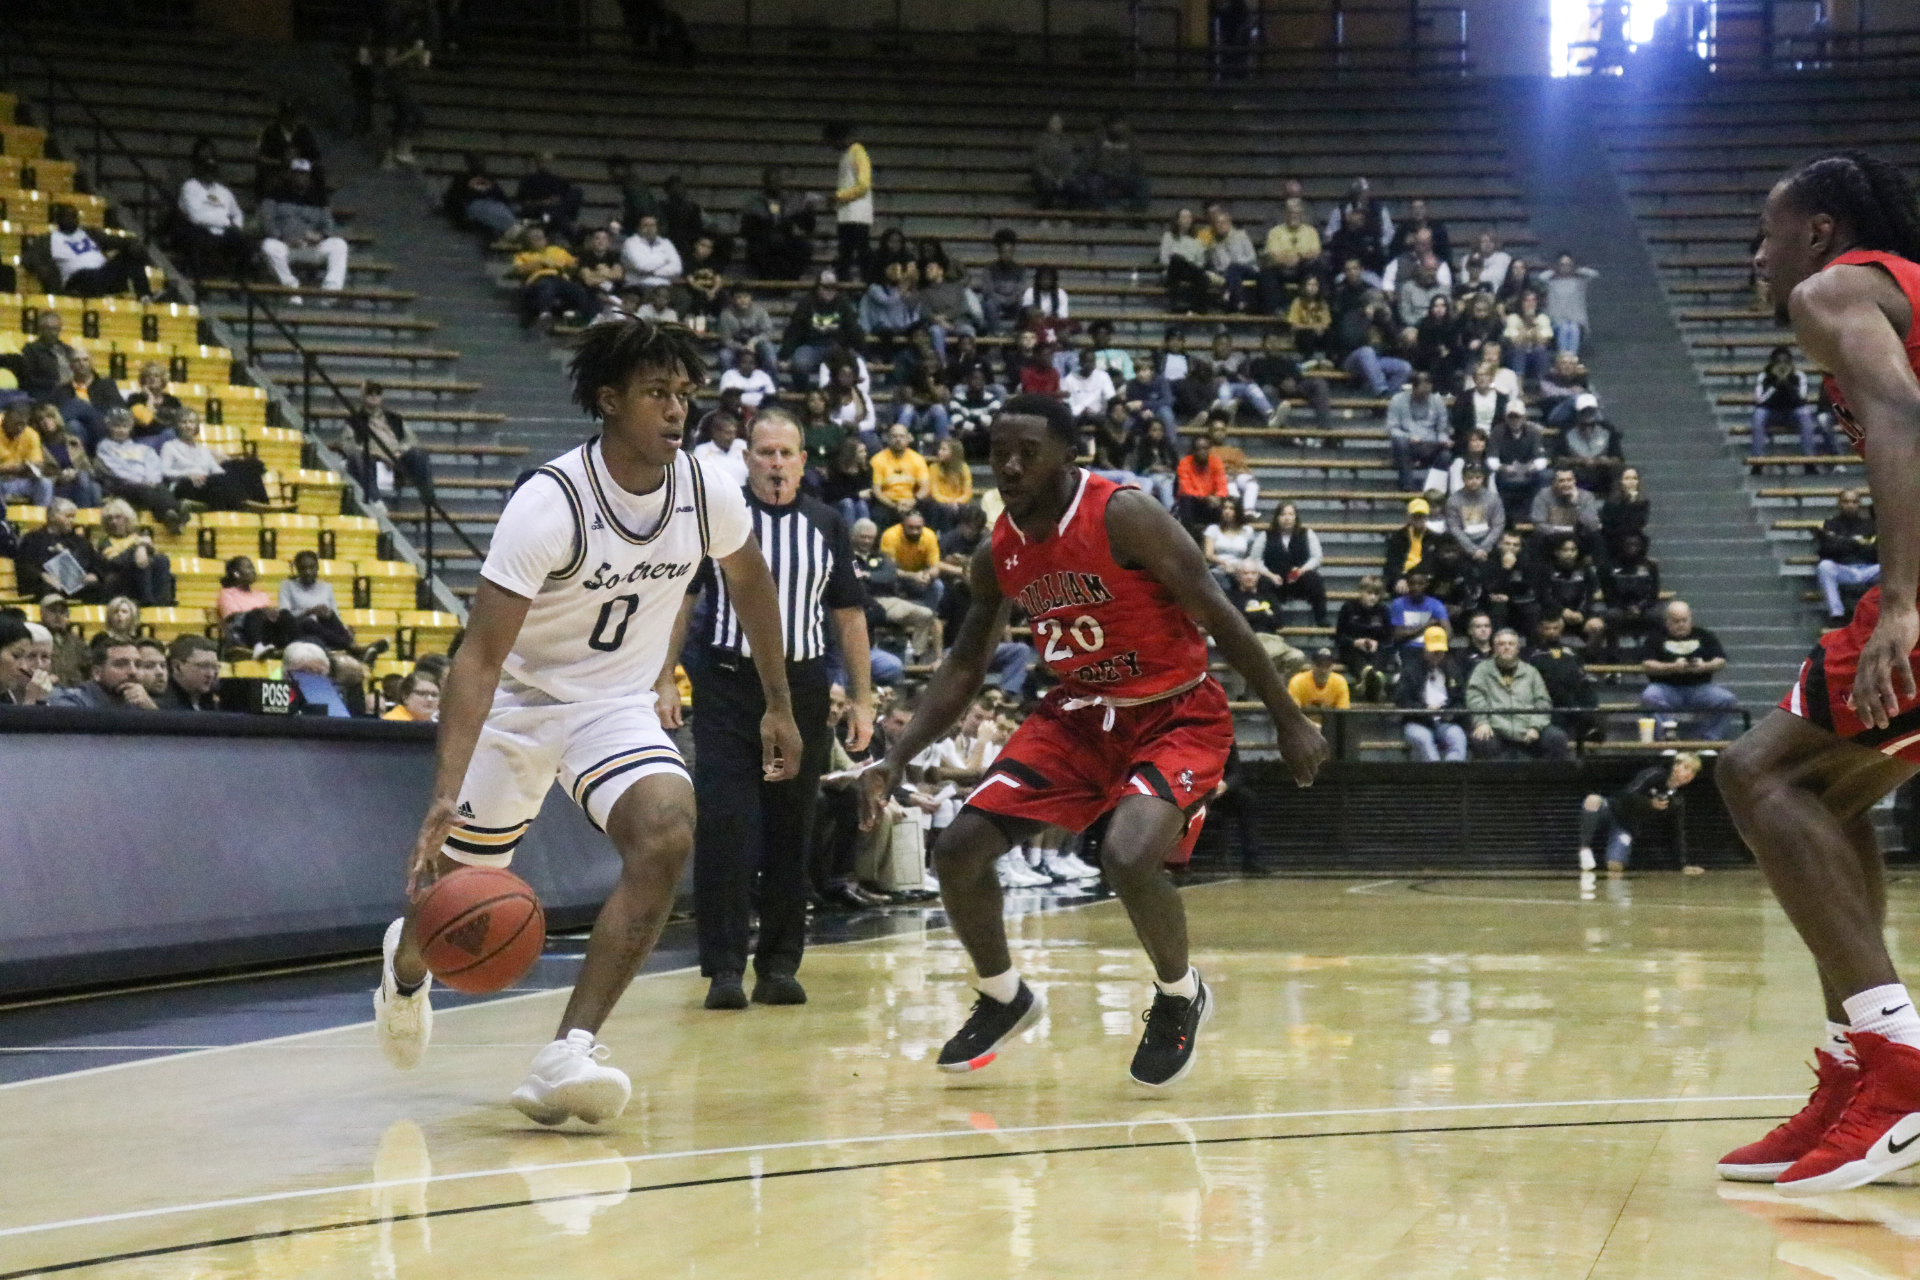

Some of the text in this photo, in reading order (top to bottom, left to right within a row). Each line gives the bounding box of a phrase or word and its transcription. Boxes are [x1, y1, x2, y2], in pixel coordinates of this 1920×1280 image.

[583, 561, 691, 590] Sothern
[588, 593, 639, 652] 0
[1037, 615, 1104, 662] 20
[262, 682, 290, 706] POSS
